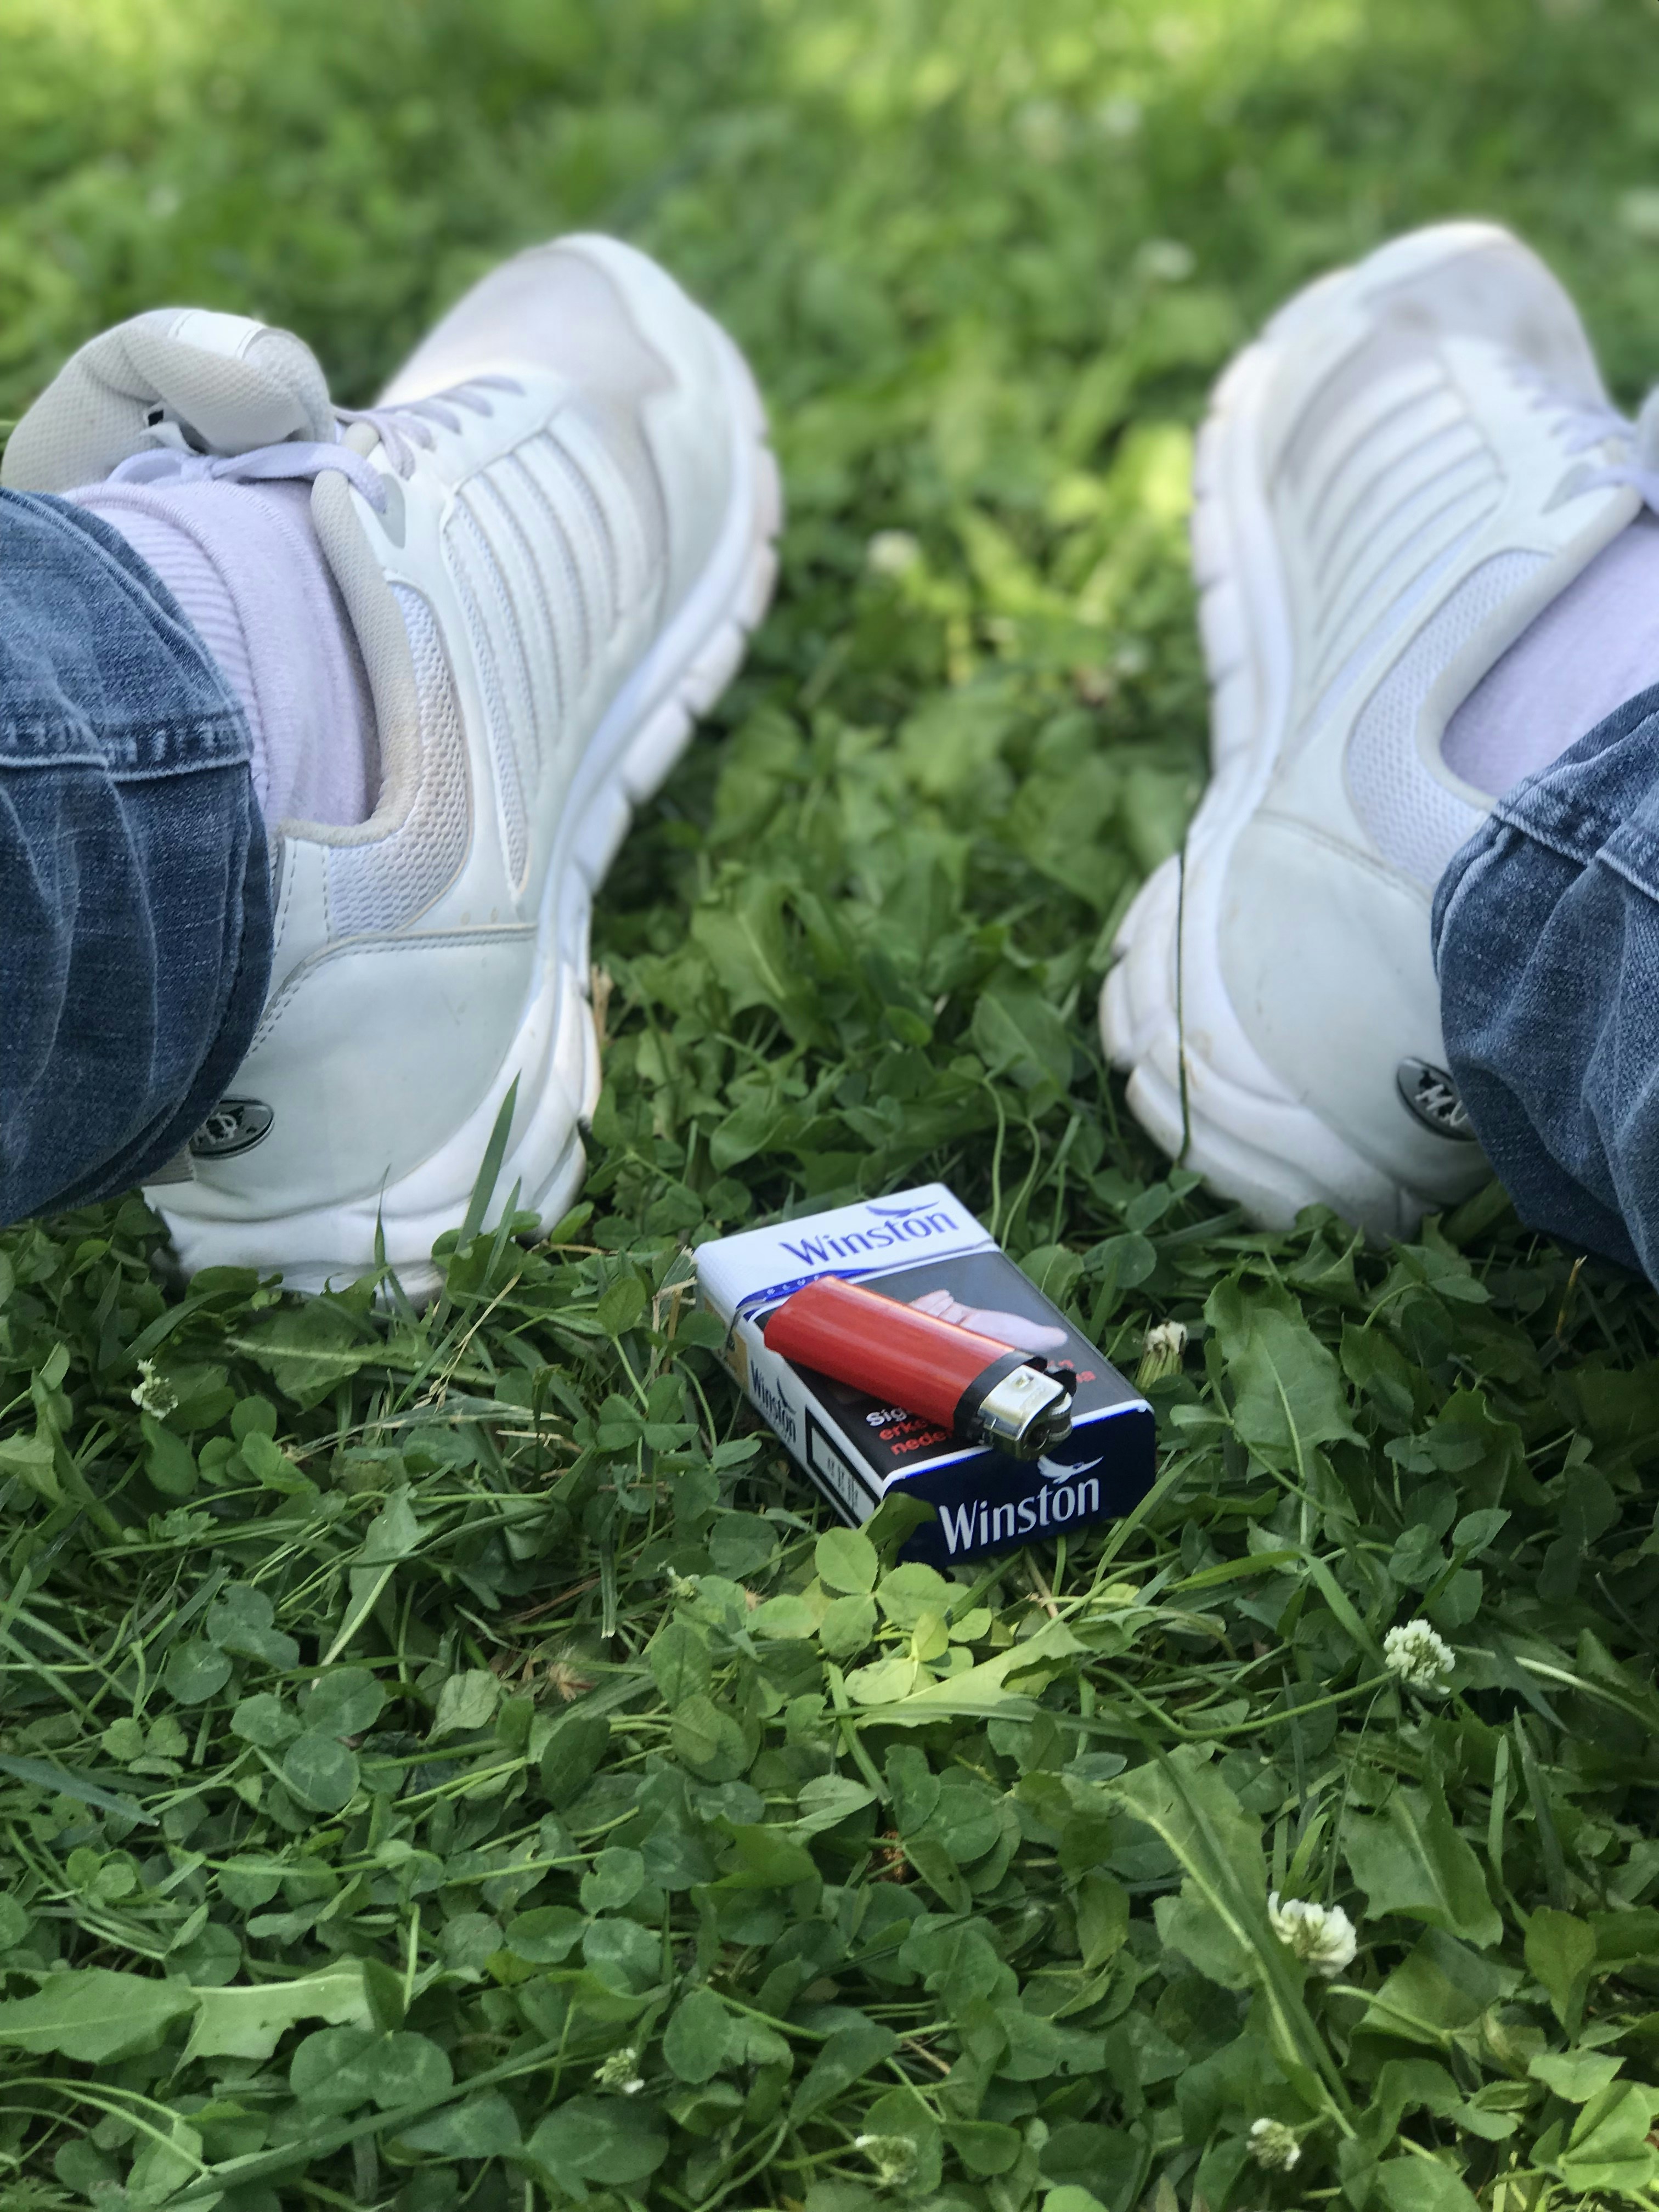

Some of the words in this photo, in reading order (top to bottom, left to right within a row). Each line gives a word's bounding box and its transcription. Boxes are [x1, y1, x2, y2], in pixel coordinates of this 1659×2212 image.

[778, 1212, 959, 1266] Winston
[866, 1407, 907, 1426] Sig
[890, 1431, 950, 1455] nede
[939, 1478, 1099, 1555] Winston
